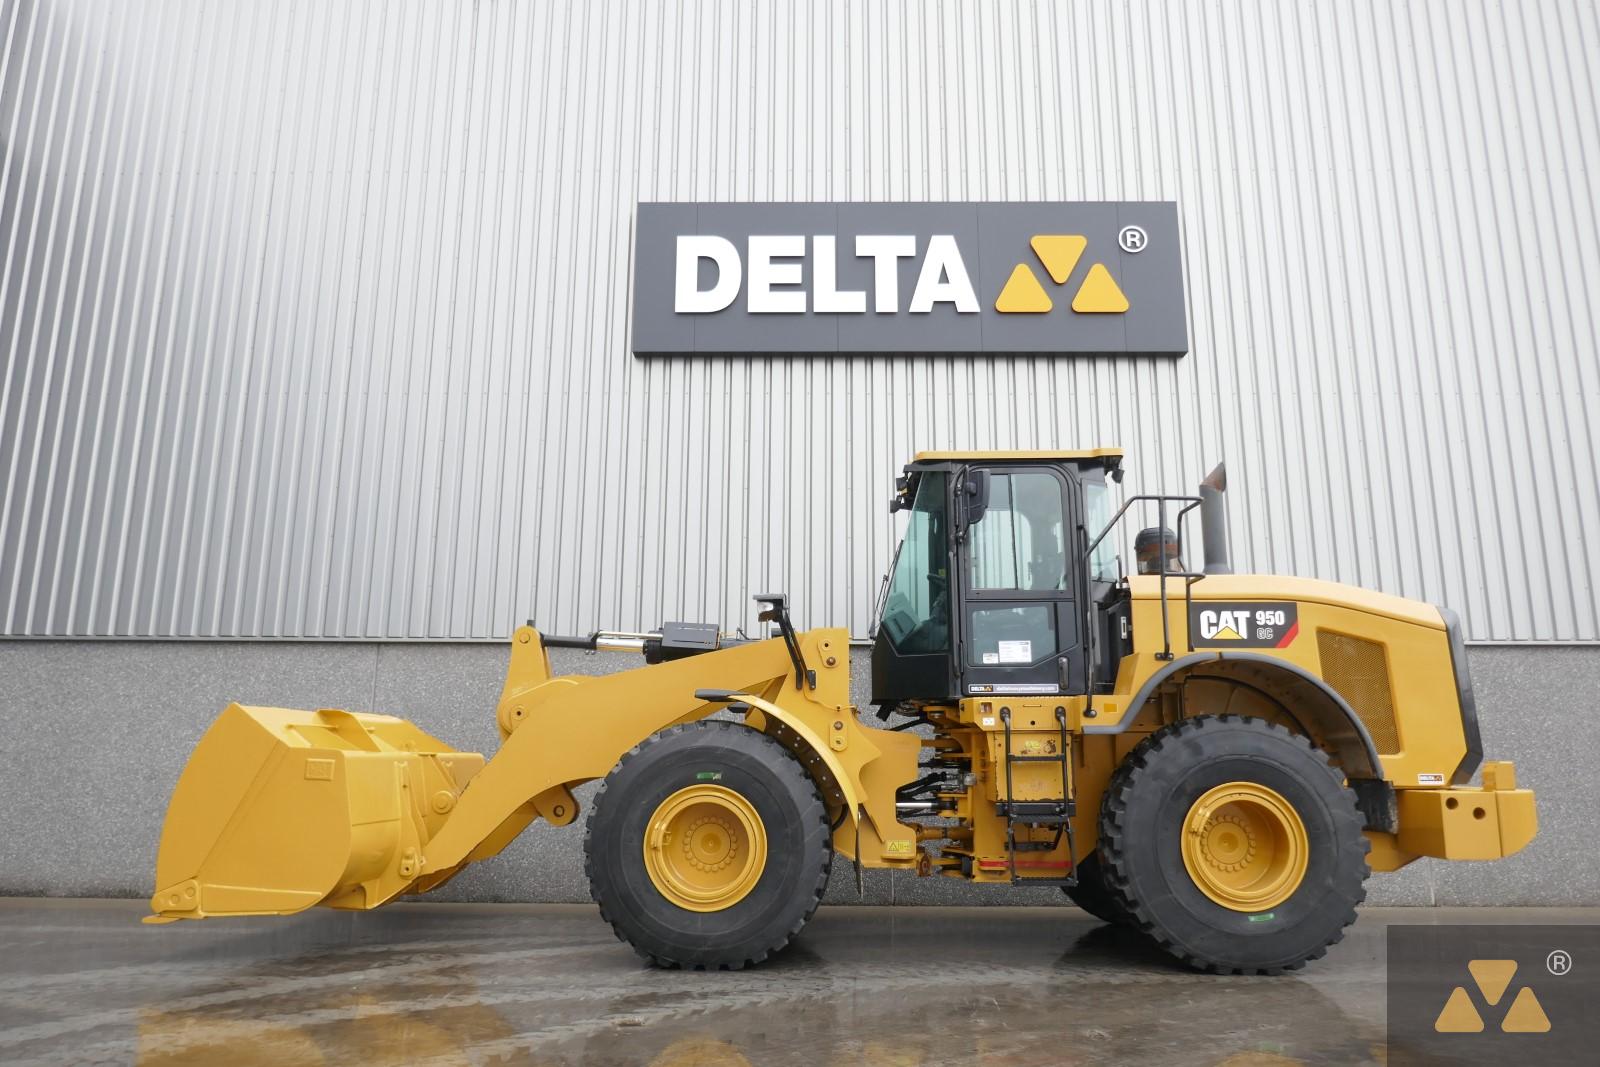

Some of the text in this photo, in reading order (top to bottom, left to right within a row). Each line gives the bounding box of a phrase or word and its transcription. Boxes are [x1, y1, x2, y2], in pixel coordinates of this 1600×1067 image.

[674, 235, 981, 313] DELTA
[1200, 610, 1285, 639] CAT 950
[1256, 627, 1274, 640] GC
